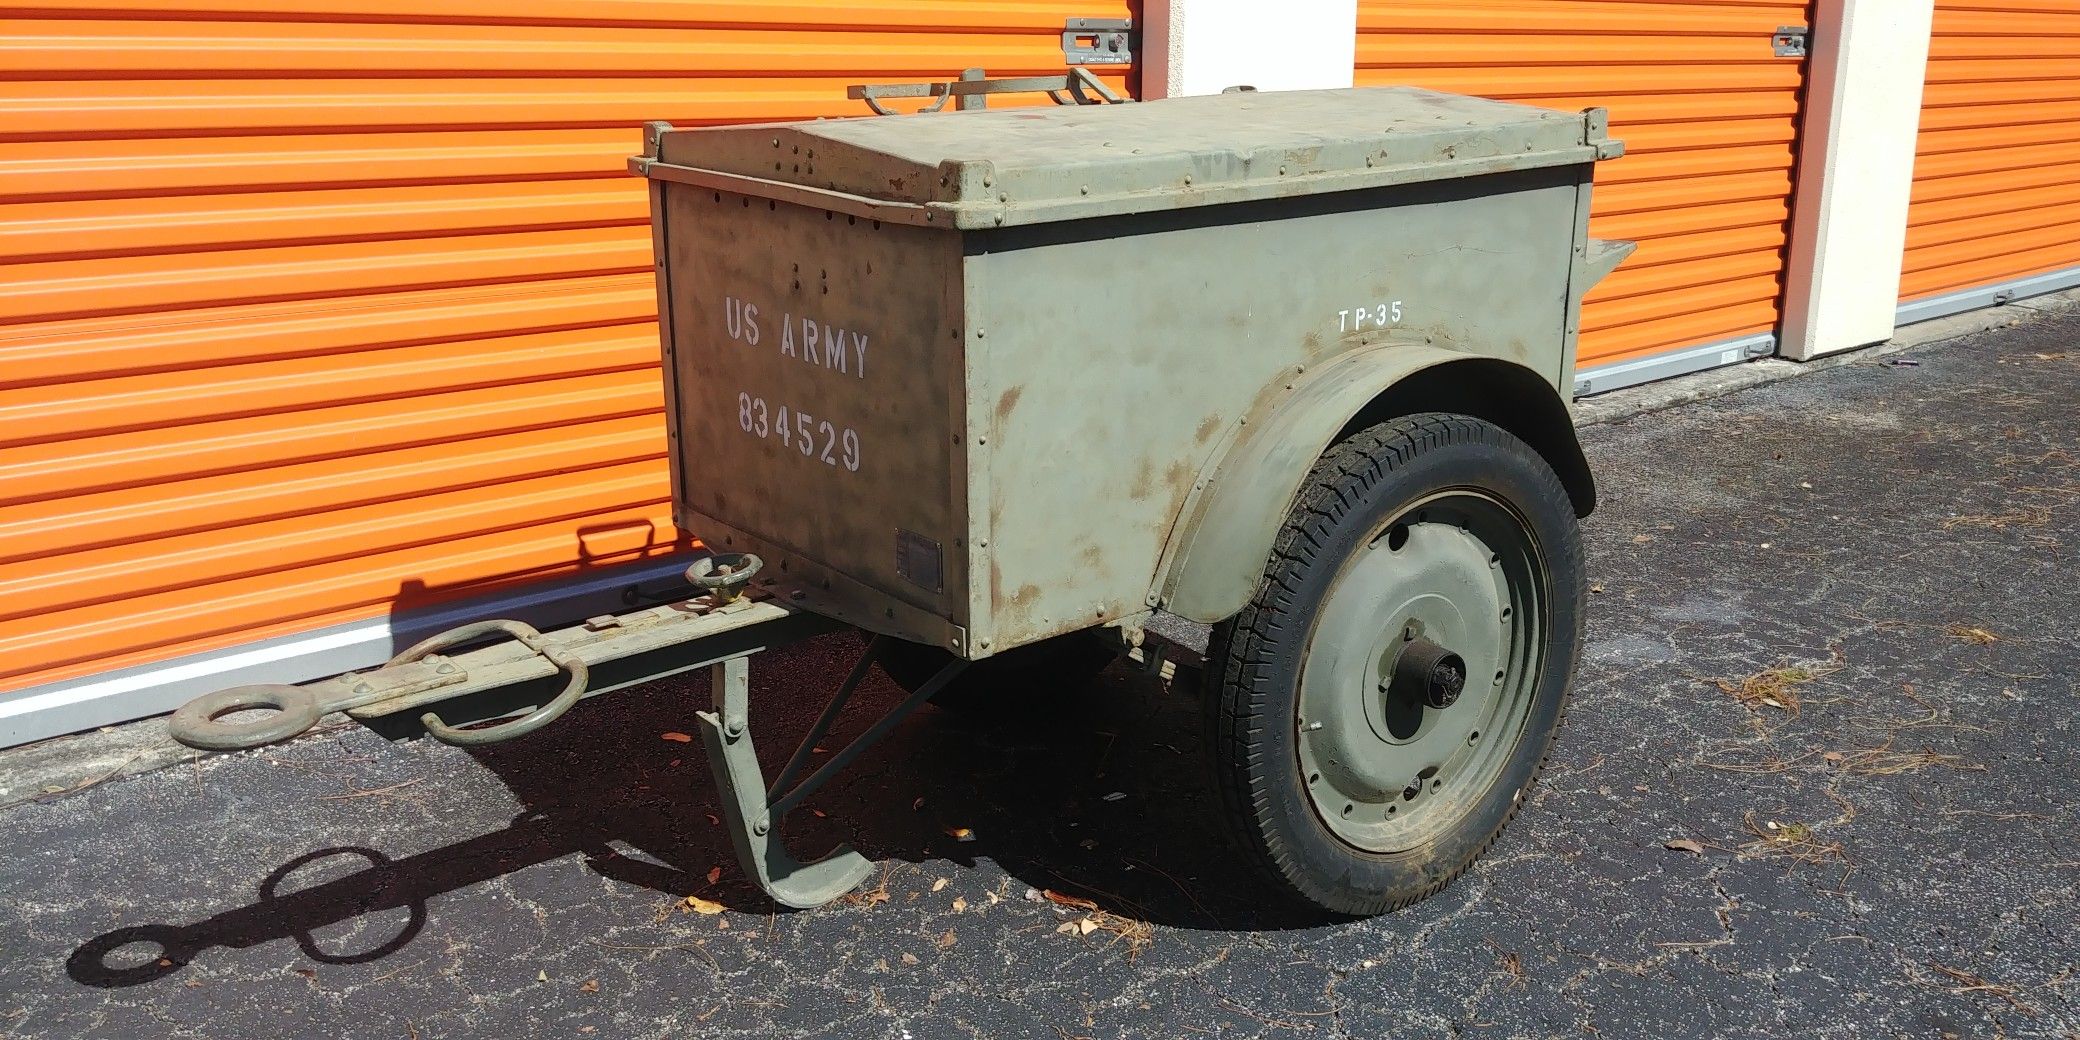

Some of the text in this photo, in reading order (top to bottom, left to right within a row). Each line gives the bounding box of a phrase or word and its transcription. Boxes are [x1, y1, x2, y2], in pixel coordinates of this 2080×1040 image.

[726, 297, 868, 378] US ARMY
[739, 392, 860, 471] 834529
